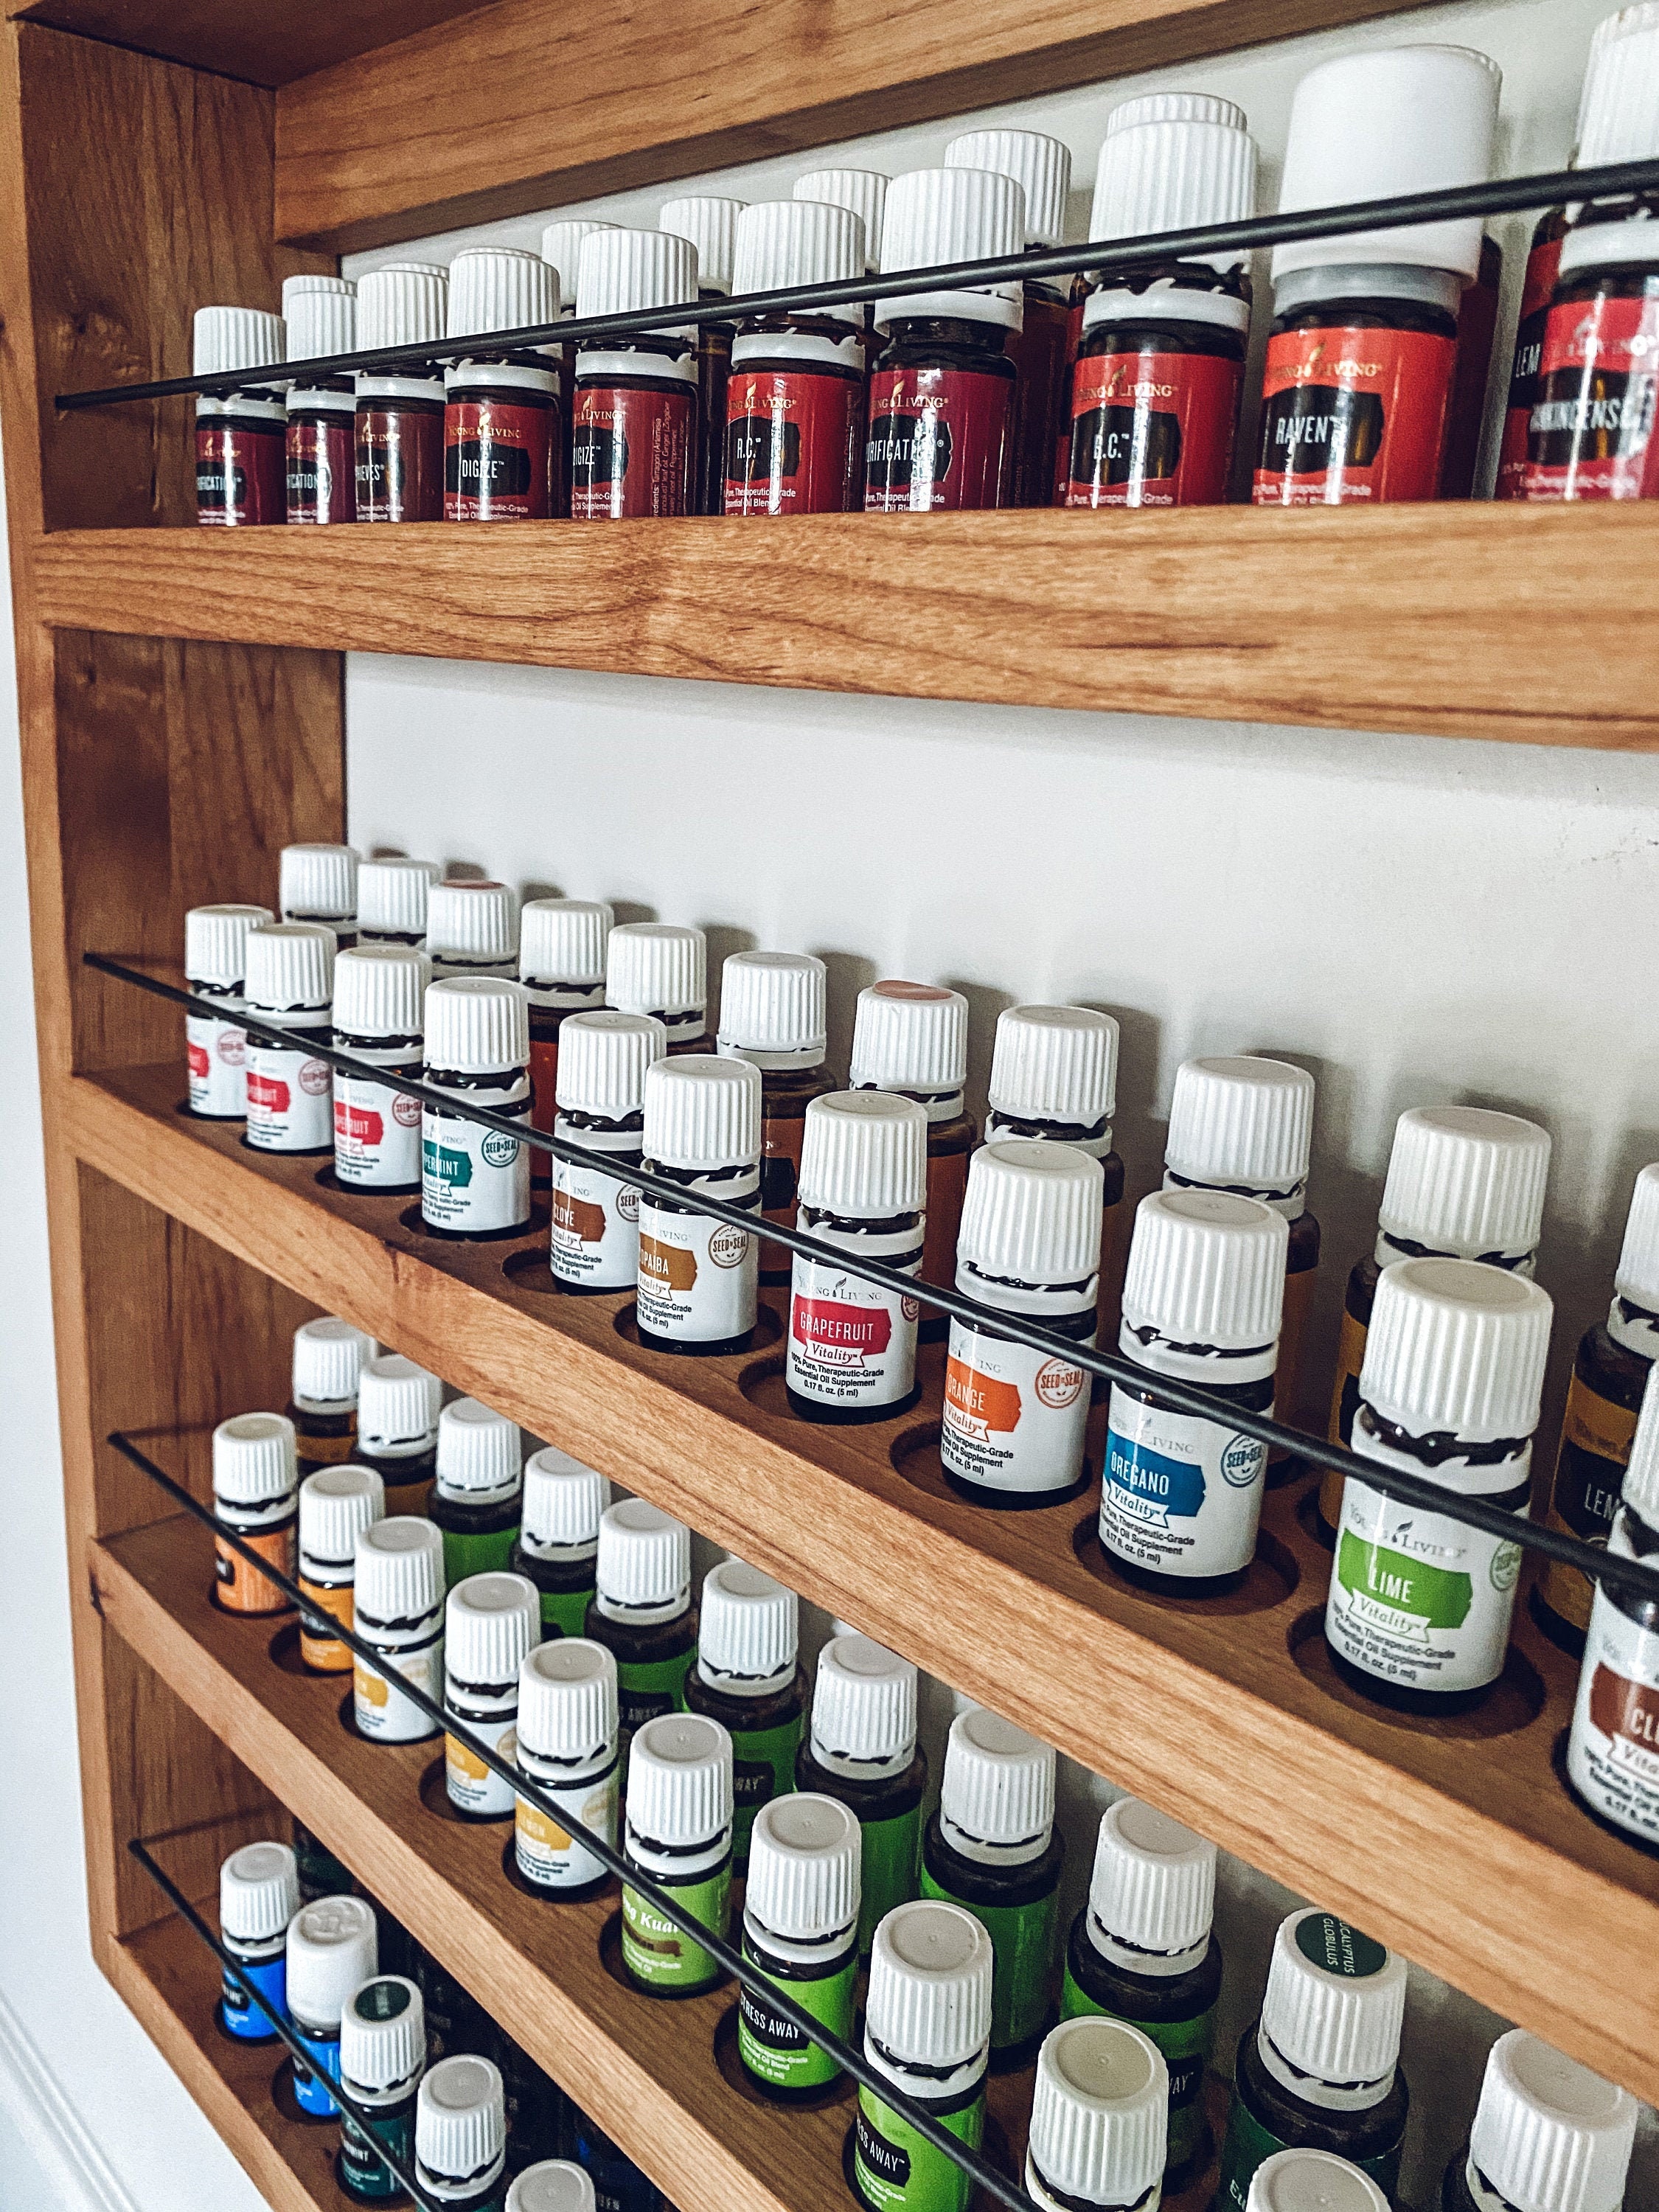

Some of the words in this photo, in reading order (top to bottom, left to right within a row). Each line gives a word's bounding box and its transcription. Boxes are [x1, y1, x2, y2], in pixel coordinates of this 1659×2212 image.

[754, 498, 774, 508] Blen
[486, 1141, 501, 1154] SEED
[620, 1195, 635, 1207] SEED
[712, 1239, 729, 1253] SEED
[733, 1236, 746, 1249] SEAL
[562, 1257, 594, 1270] Supplement
[798, 1274, 830, 1296] YNG
[841, 1288, 883, 1301] LIVNG
[642, 1293, 692, 1313] Therapeutic-Grade
[649, 1307, 684, 1321] Supplement
[659, 1318, 669, 1329] ml)
[800, 1311, 874, 1341] GRAPEFRUIT
[794, 1364, 818, 1380] Essential
[820, 1374, 830, 1384] Oil
[831, 1377, 876, 1388] Supplement
[802, 1359, 818, 1372] Pure,
[818, 1364, 884, 1378] Therapeutic-Grade
[804, 1380, 816, 1390] 0.17
[837, 1387, 845, 1397] (5
[846, 1388, 859, 1398] ml)
[1040, 1373, 1060, 1389] SEED
[947, 1373, 986, 1411] ORANGE
[951, 1431, 1015, 1459] Therapeutic-Grade
[959, 1445, 1004, 1468] Supplement
[964, 1458, 971, 1471] (5
[972, 1465, 984, 1476] ml)
[1110, 1450, 1170, 1496] OREGANO
[1119, 1513, 1195, 1545] Therapeutic-Grade
[1120, 1527, 1130, 1540] Oil
[1131, 1533, 1183, 1556] Supplement
[1136, 1545, 1145, 1559] (5
[1146, 1551, 1161, 1565] ml)
[1368, 1562, 1413, 1604] LIME
[1365, 1625, 1456, 1660] Therapeutic-Grade
[1381, 1648, 1442, 1670] Supplement
[1323, 1918, 1339, 1966] GLOBULUS
[768, 2019, 799, 2039] AWAY
